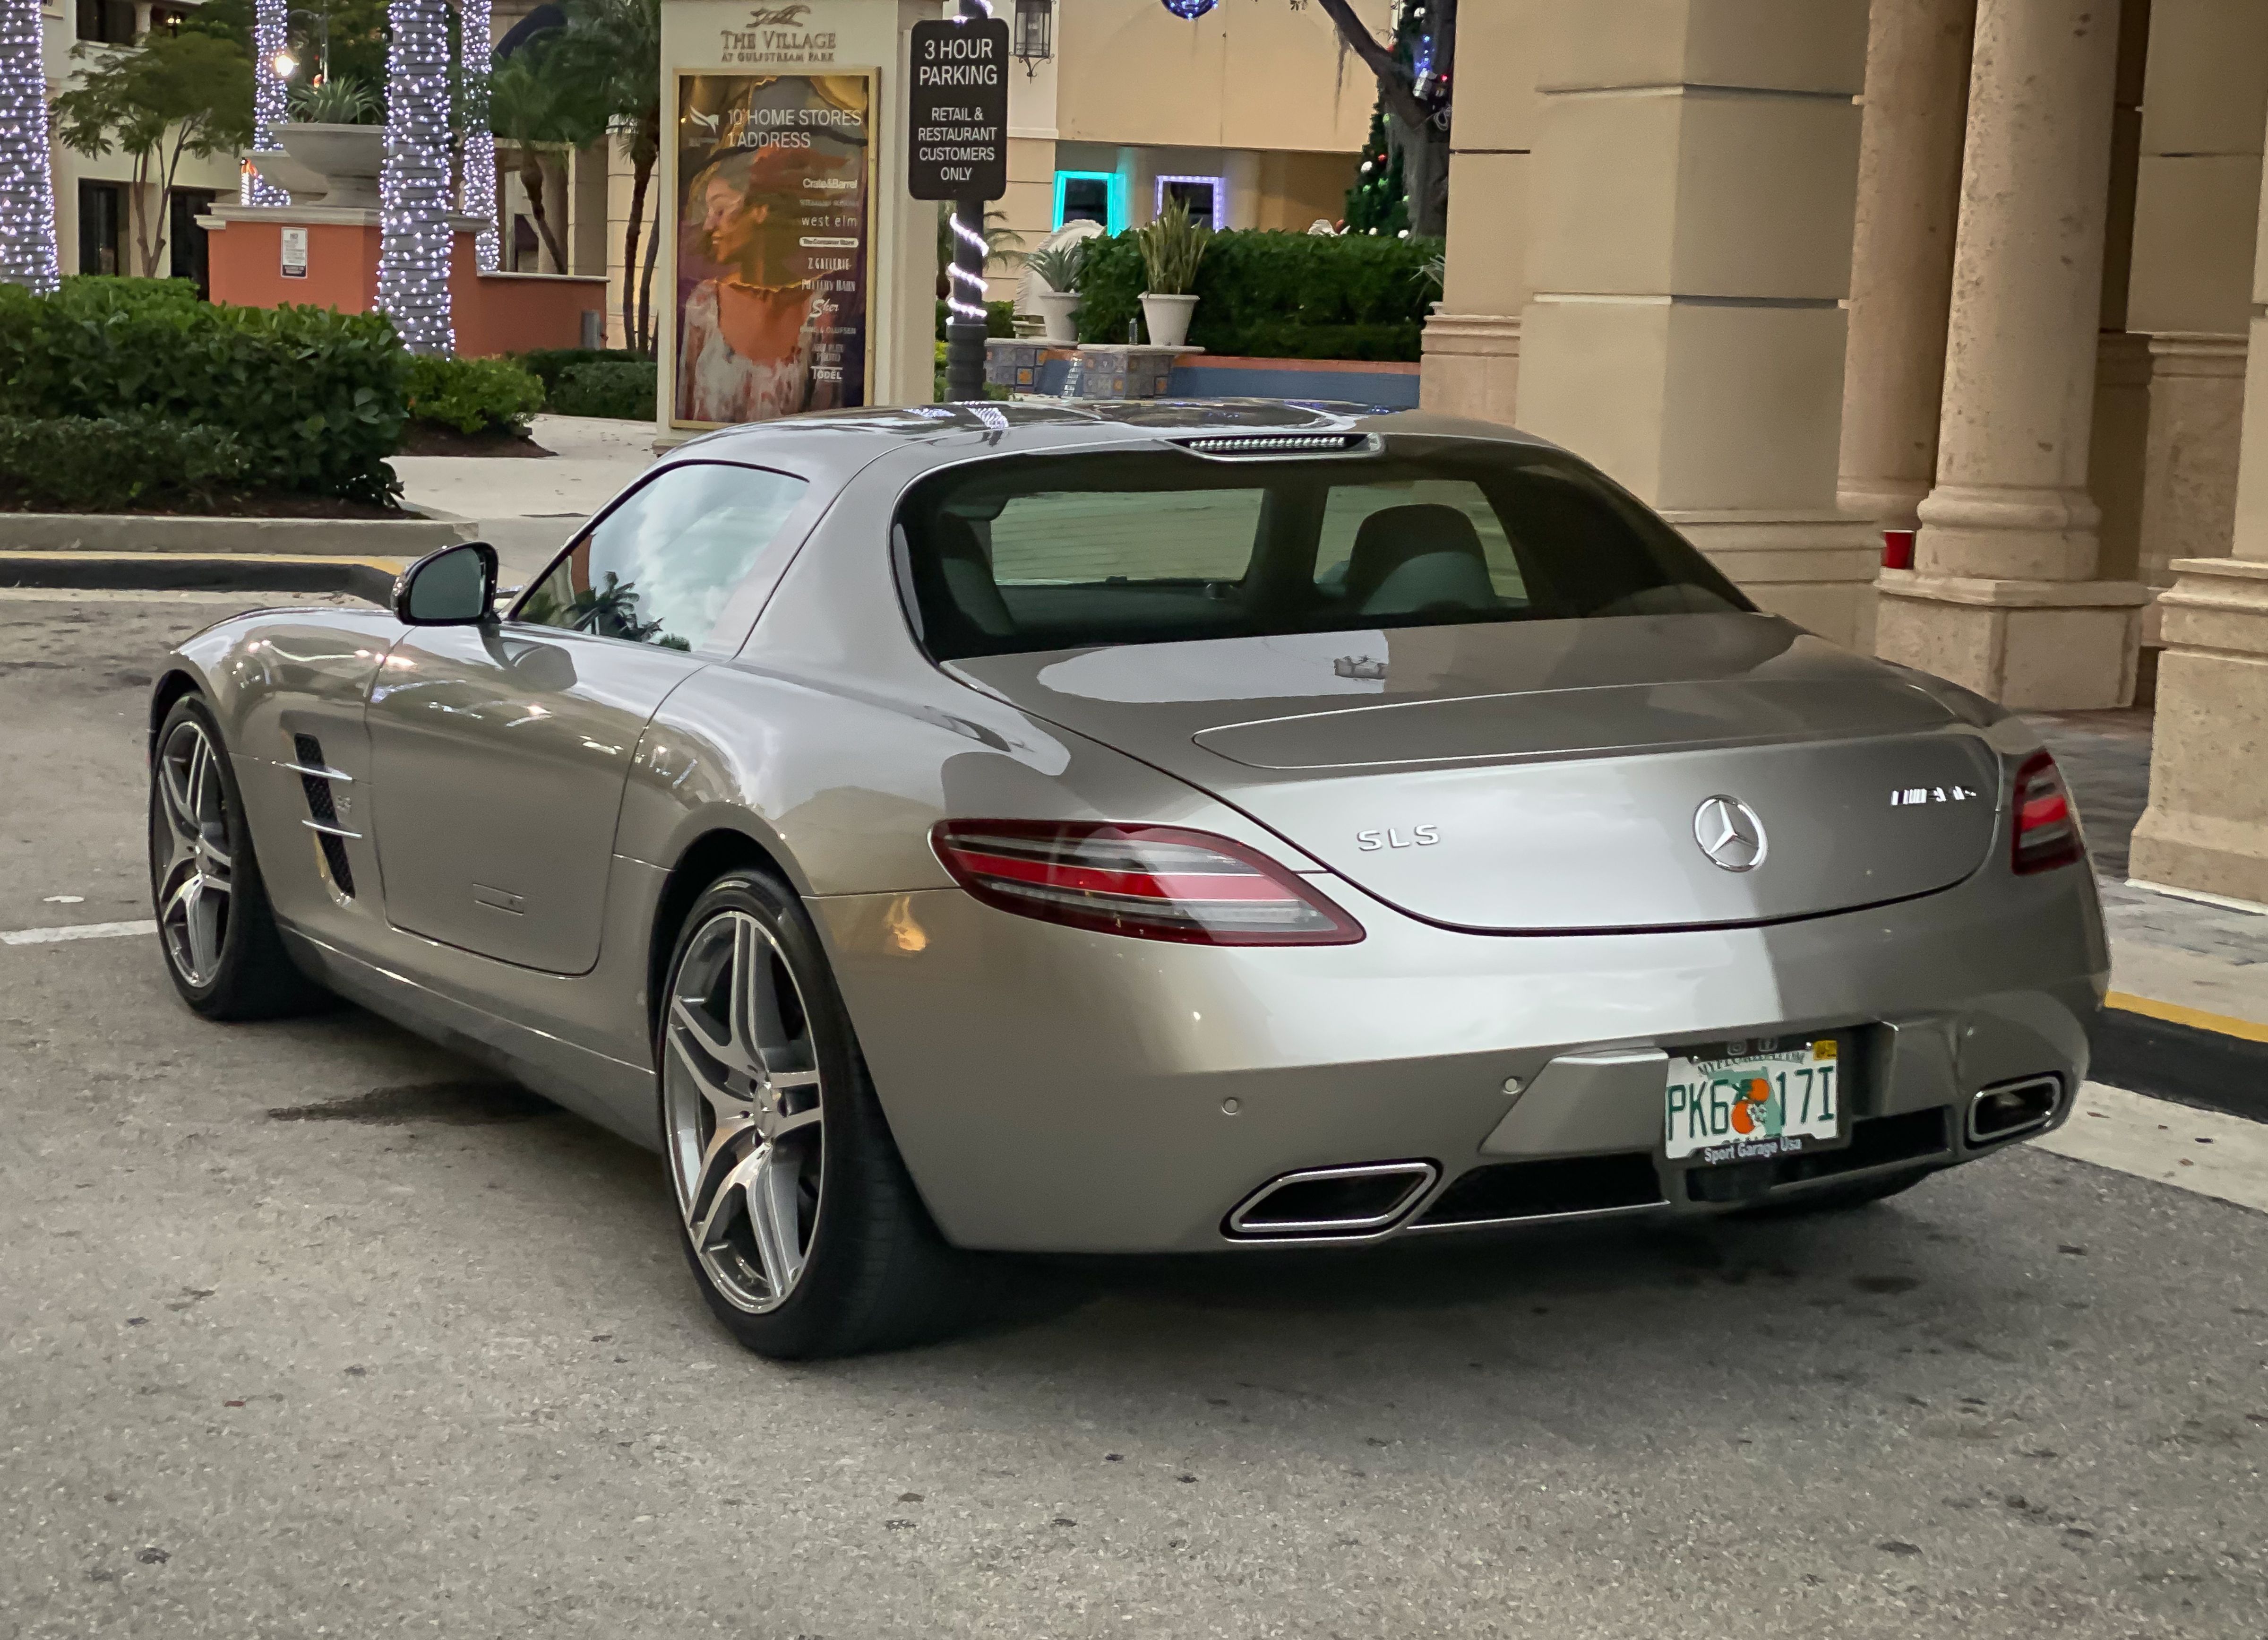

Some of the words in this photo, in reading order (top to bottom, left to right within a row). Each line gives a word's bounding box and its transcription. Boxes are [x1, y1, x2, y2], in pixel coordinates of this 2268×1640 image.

[721, 30, 756, 50] THE
[763, 30, 836, 50] VILLAGE
[924, 39, 935, 60] 3
[940, 38, 992, 59] HOUR
[919, 64, 997, 86] PARKING
[747, 109, 794, 126] HOME
[799, 109, 862, 126] STORES
[932, 107, 972, 121] RETAIL
[974, 107, 984, 121] &
[736, 131, 811, 148] ADDRESS
[918, 127, 997, 141] RESTAURANT
[919, 147, 995, 161] CUSTOMERS
[940, 166, 972, 181] ONLY
[801, 215, 830, 227] west
[834, 215, 857, 227] elm
[1357, 824, 1440, 852] SLS
[1667, 1078, 1730, 1141] PK6
